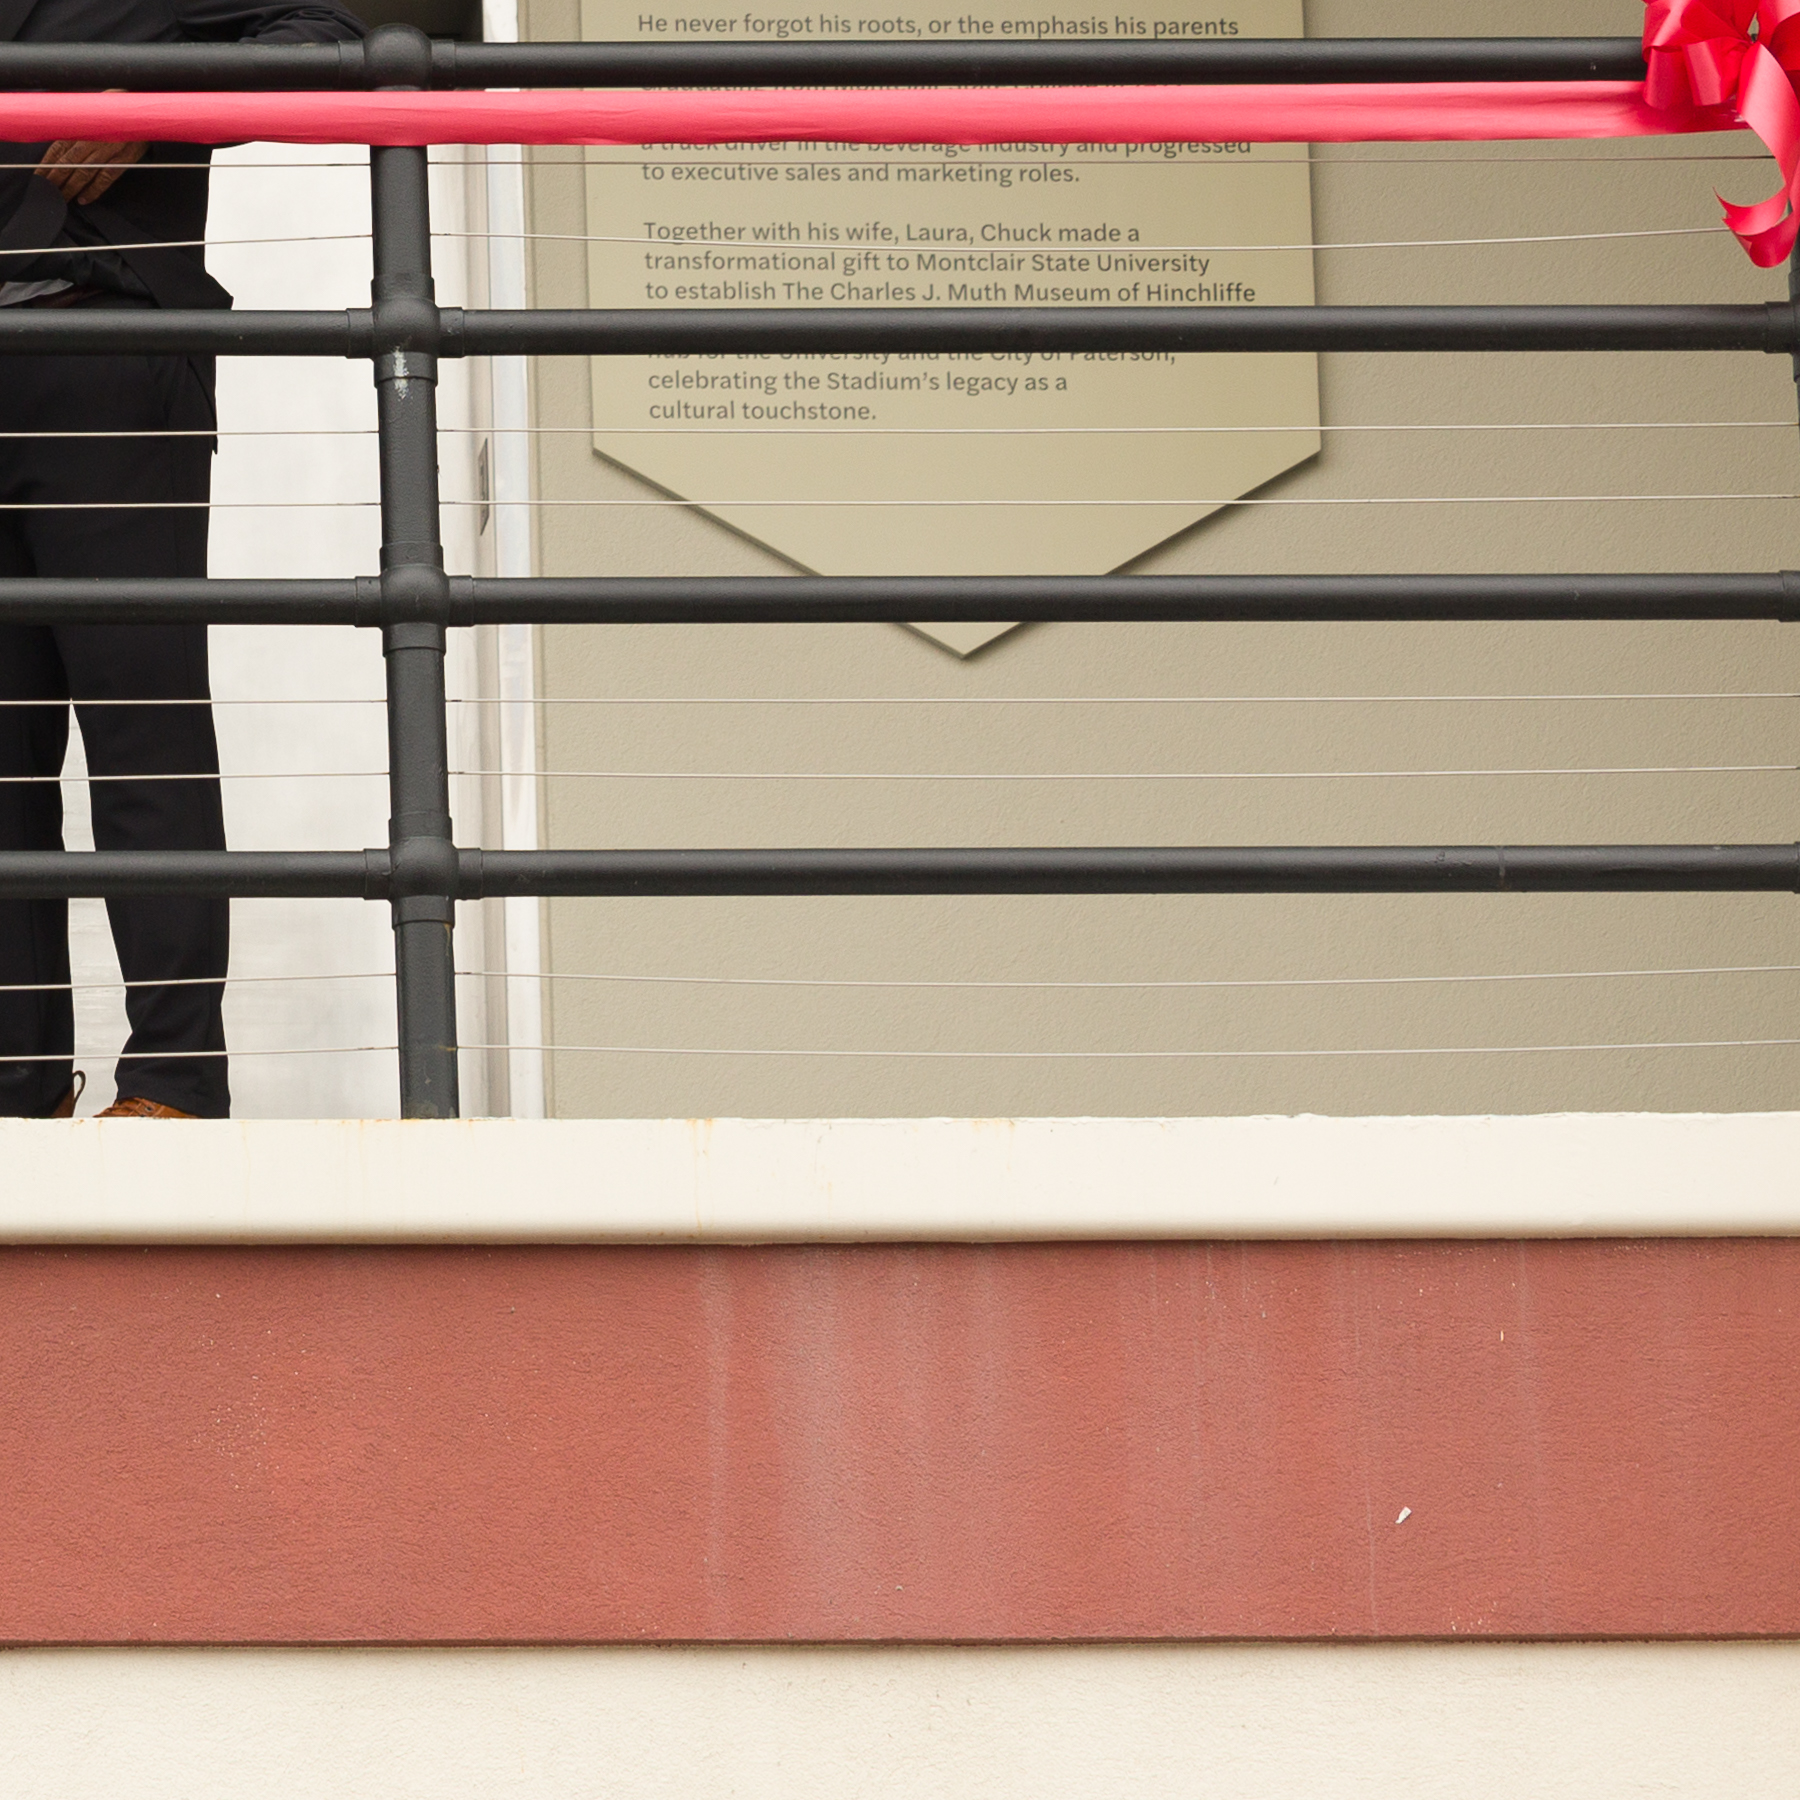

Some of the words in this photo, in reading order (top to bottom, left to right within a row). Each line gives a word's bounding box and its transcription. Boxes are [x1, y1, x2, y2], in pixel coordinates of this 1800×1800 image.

[638, 14, 668, 33] He
[674, 17, 738, 33] never
[742, 12, 814, 39] forgot
[819, 13, 853, 35] his
[858, 15, 922, 39] roots,
[927, 19, 953, 35] or
[957, 14, 996, 35] the
[1001, 15, 1109, 38] emphasis
[1115, 15, 1148, 36] his
[1153, 17, 1240, 38] parents
[641, 164, 665, 181] to
[670, 163, 779, 182] executive
[784, 163, 842, 182] sales
[847, 163, 890, 182] and
[896, 164, 1013, 189] marketing
[1019, 163, 1080, 183] roles.
[643, 221, 747, 246] Together
[752, 221, 801, 243] with
[807, 221, 840, 243] his
[846, 221, 901, 247] wife,
[905, 222, 975, 247] Laura,
[980, 222, 1052, 243] Chuck
[1058, 222, 1122, 243] made
[1126, 228, 1141, 243] a
[643, 250, 837, 272] transformational
[842, 250, 882, 277] gift
[886, 253, 911, 272] to
[915, 251, 1027, 273] Montclair
[1031, 252, 1091, 273] State
[1096, 252, 1211, 278] University
[644, 281, 669, 300] to
[674, 280, 776, 301] establish
[781, 280, 824, 301] The
[829, 280, 917, 302] Charles
[921, 283, 941, 302] J.
[947, 281, 1007, 302] Muth
[1014, 283, 1111, 302] Museum
[1117, 281, 1141, 303] of
[1146, 281, 1256, 303] Hinchliffe
[648, 369, 778, 396] celebrating
[782, 370, 821, 391] the
[946, 370, 1019, 397] legacy
[1024, 376, 1050, 392] as
[1054, 376, 1068, 392] a
[648, 399, 736, 420] cultural
[741, 399, 877, 420] touchstone.
